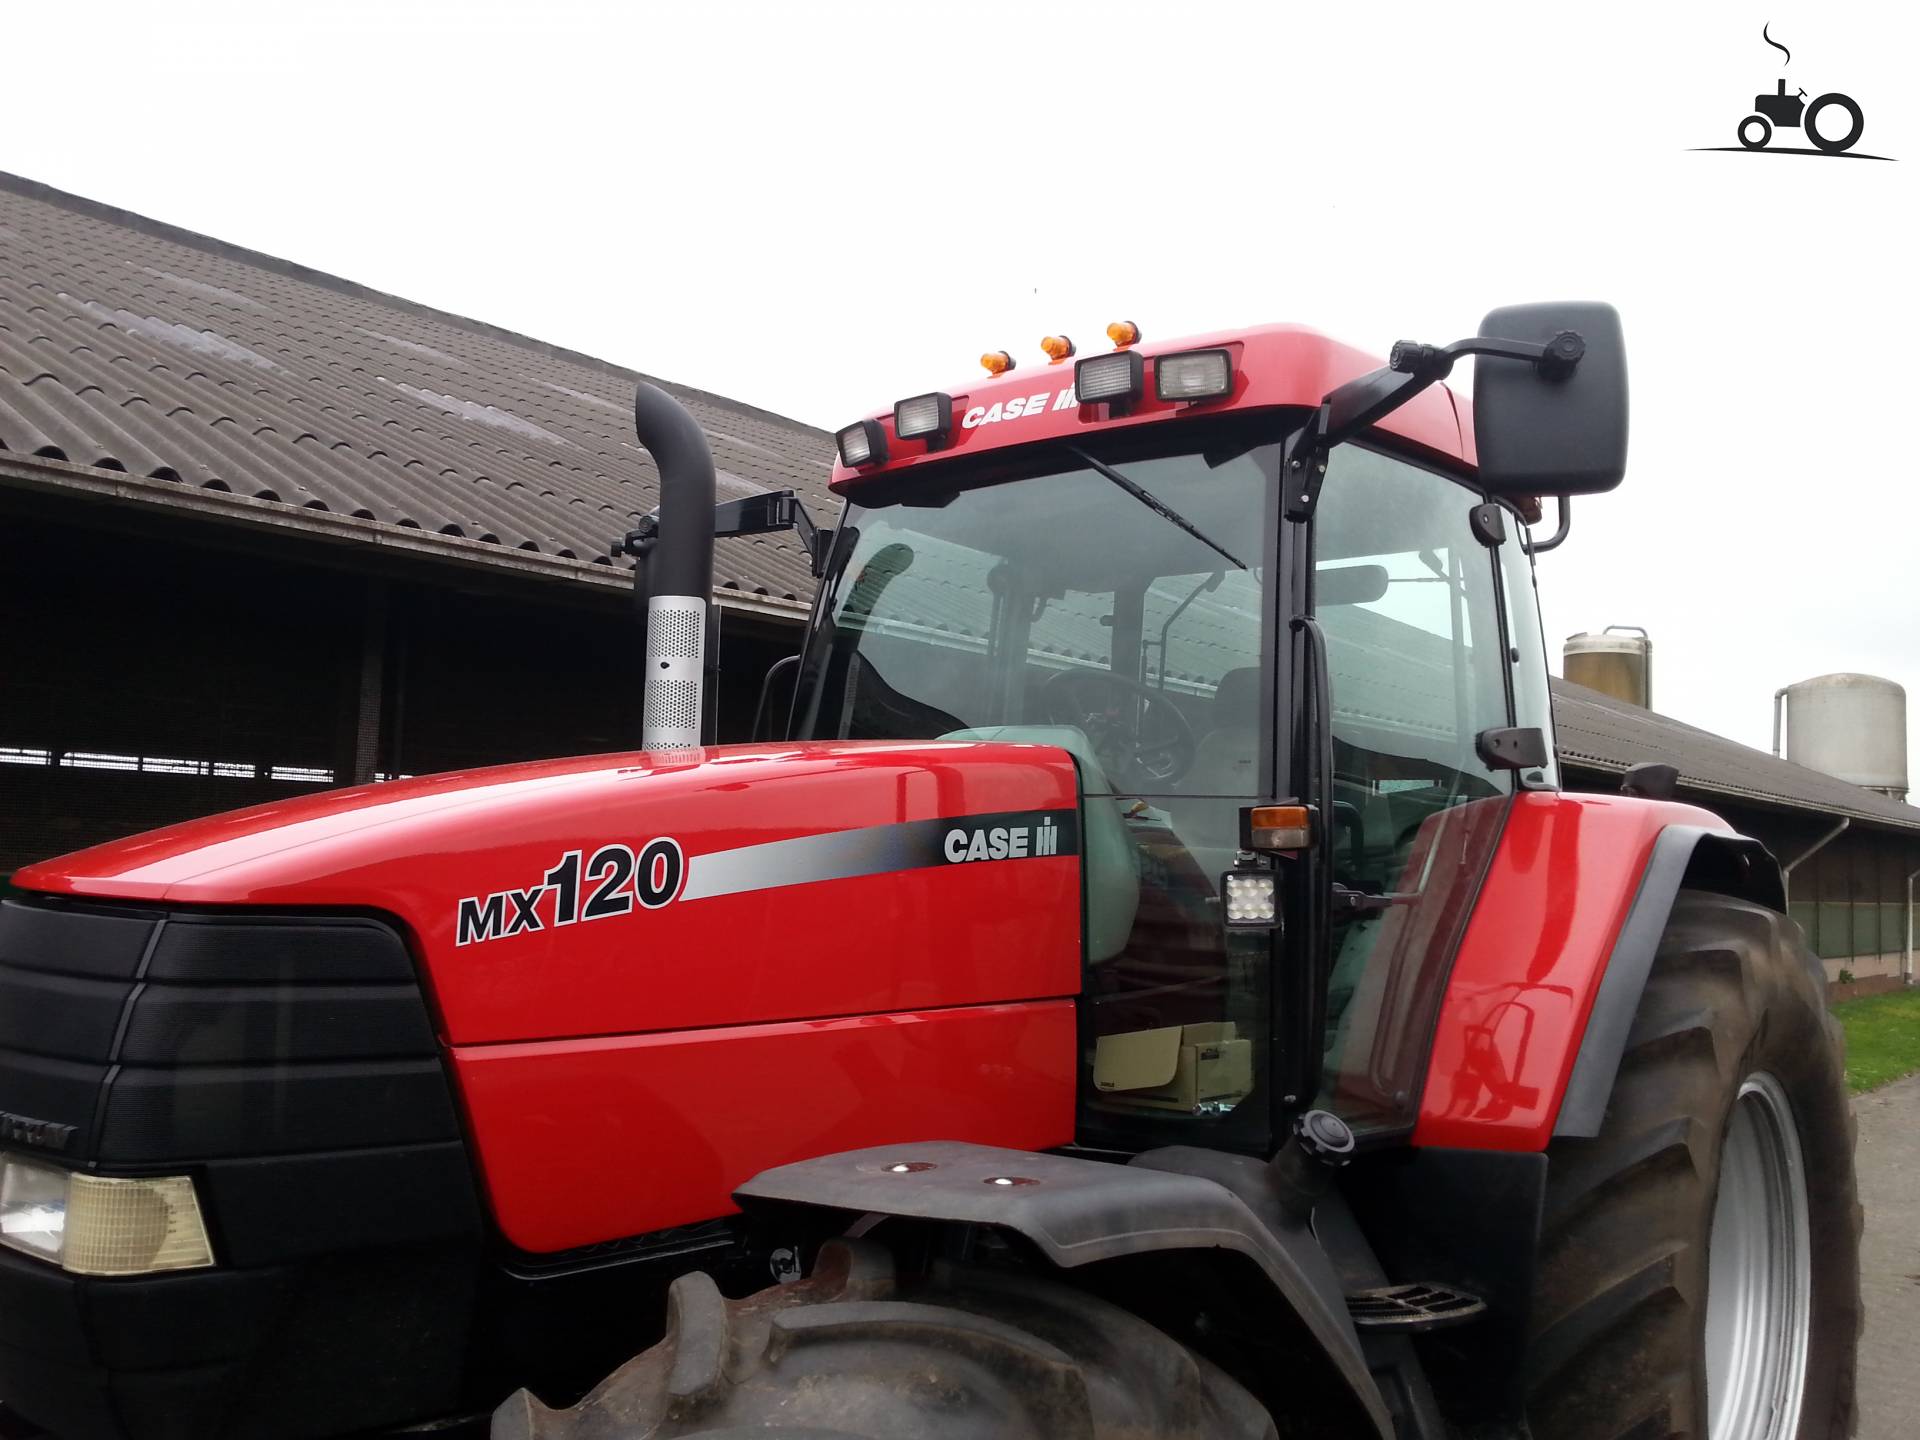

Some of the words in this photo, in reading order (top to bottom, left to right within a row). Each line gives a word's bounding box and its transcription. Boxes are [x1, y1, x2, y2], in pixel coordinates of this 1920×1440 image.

[962, 393, 1051, 429] CASE
[944, 827, 1029, 863] CASE
[456, 836, 684, 947] MX120
